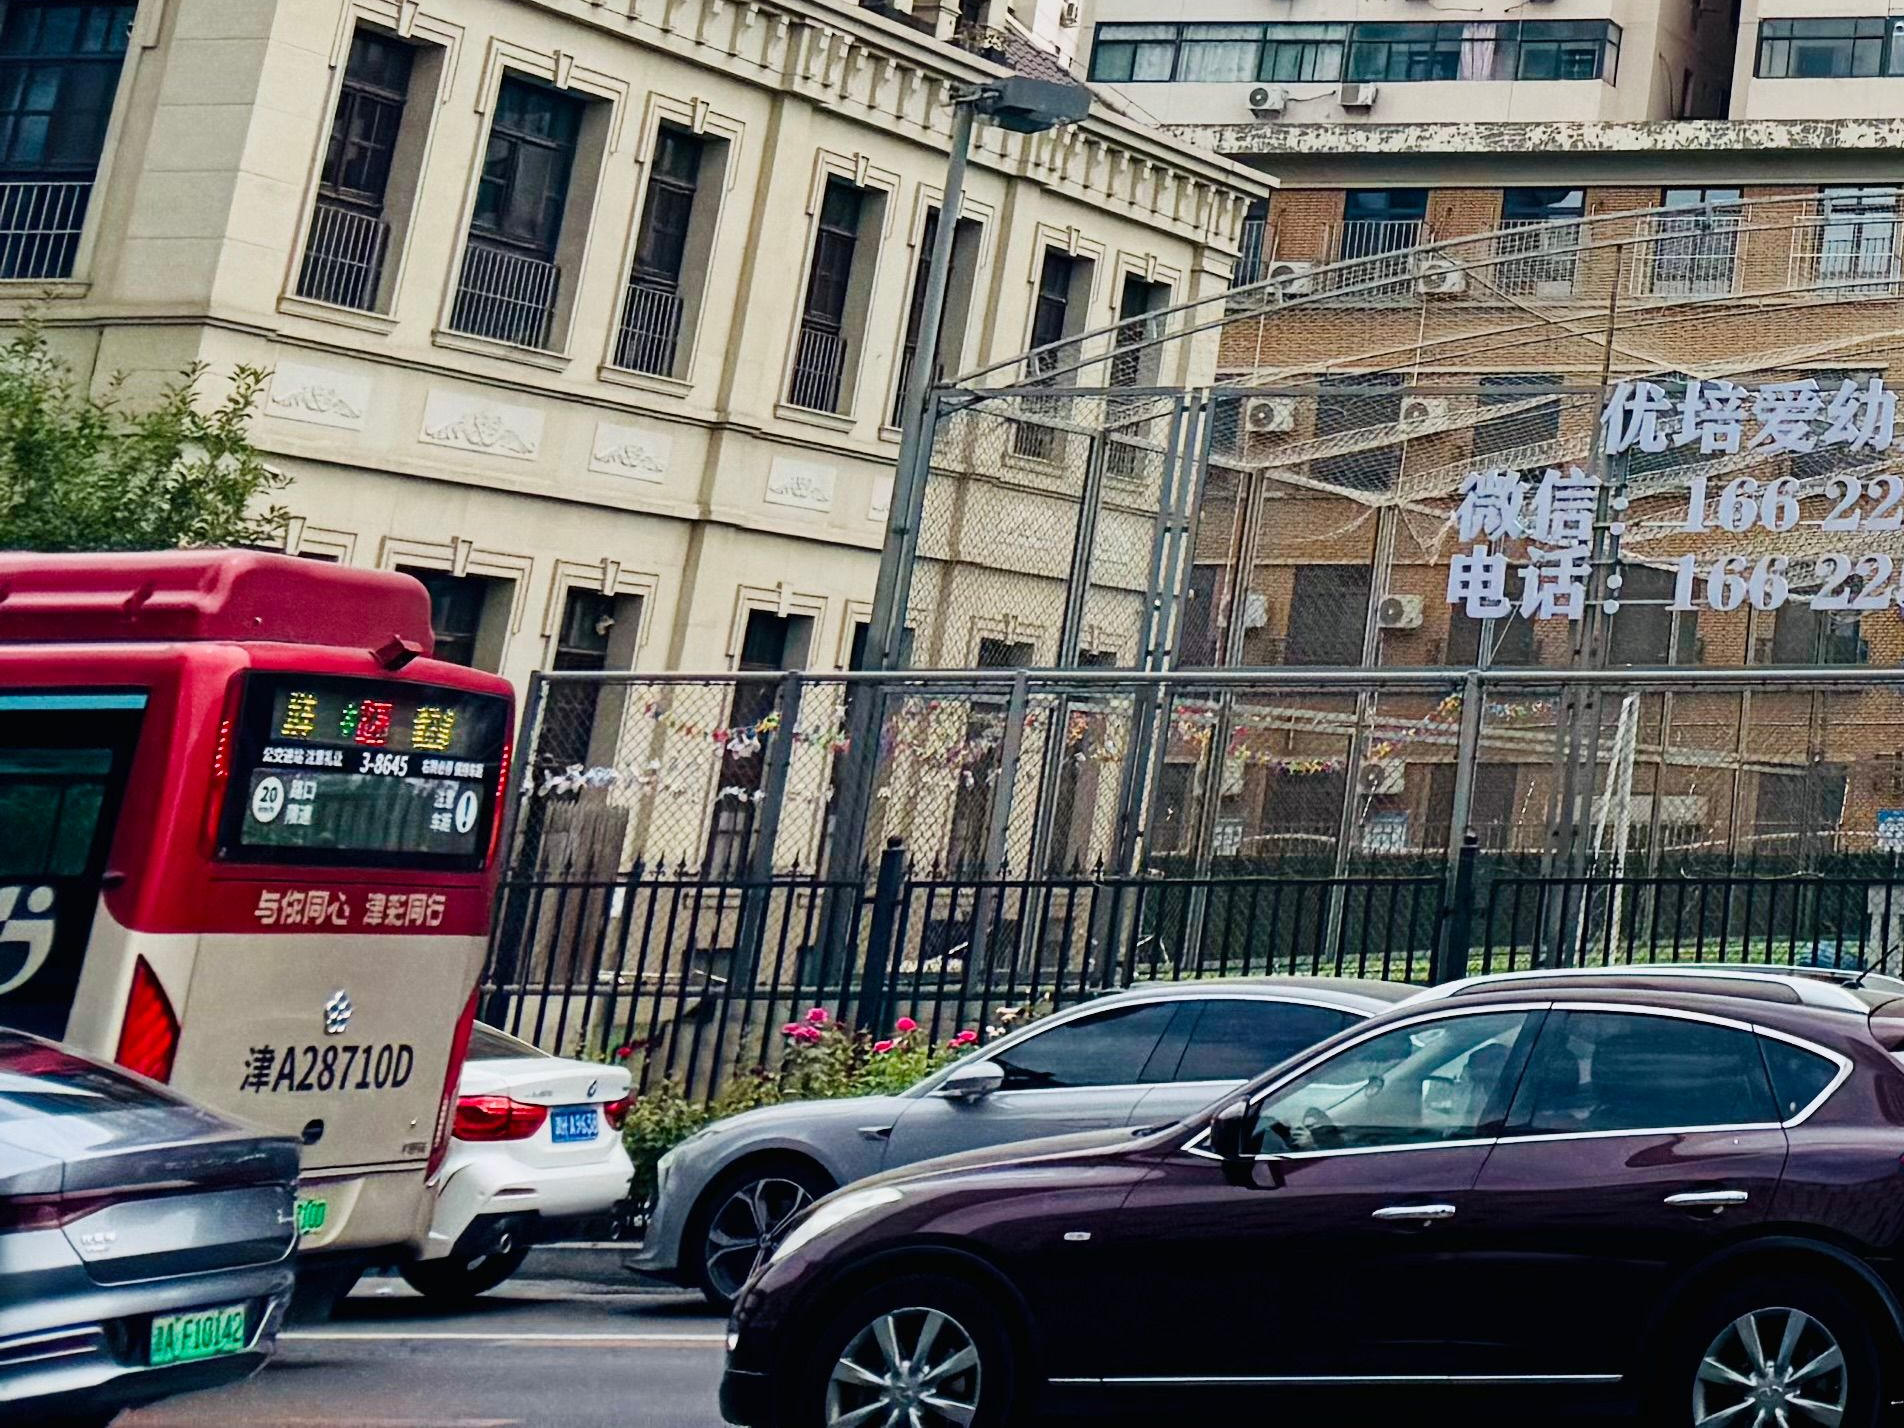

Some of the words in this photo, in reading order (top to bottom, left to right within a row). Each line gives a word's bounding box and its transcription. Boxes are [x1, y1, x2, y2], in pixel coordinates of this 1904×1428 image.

[1680, 476, 1800, 533] 166
[1665, 553, 1790, 612] 166
[358, 751, 410, 777] 3-8645
[261, 785, 278, 803] 20
[254, 889, 350, 926] 与你同心
[239, 1043, 415, 1094] 津A28710D
